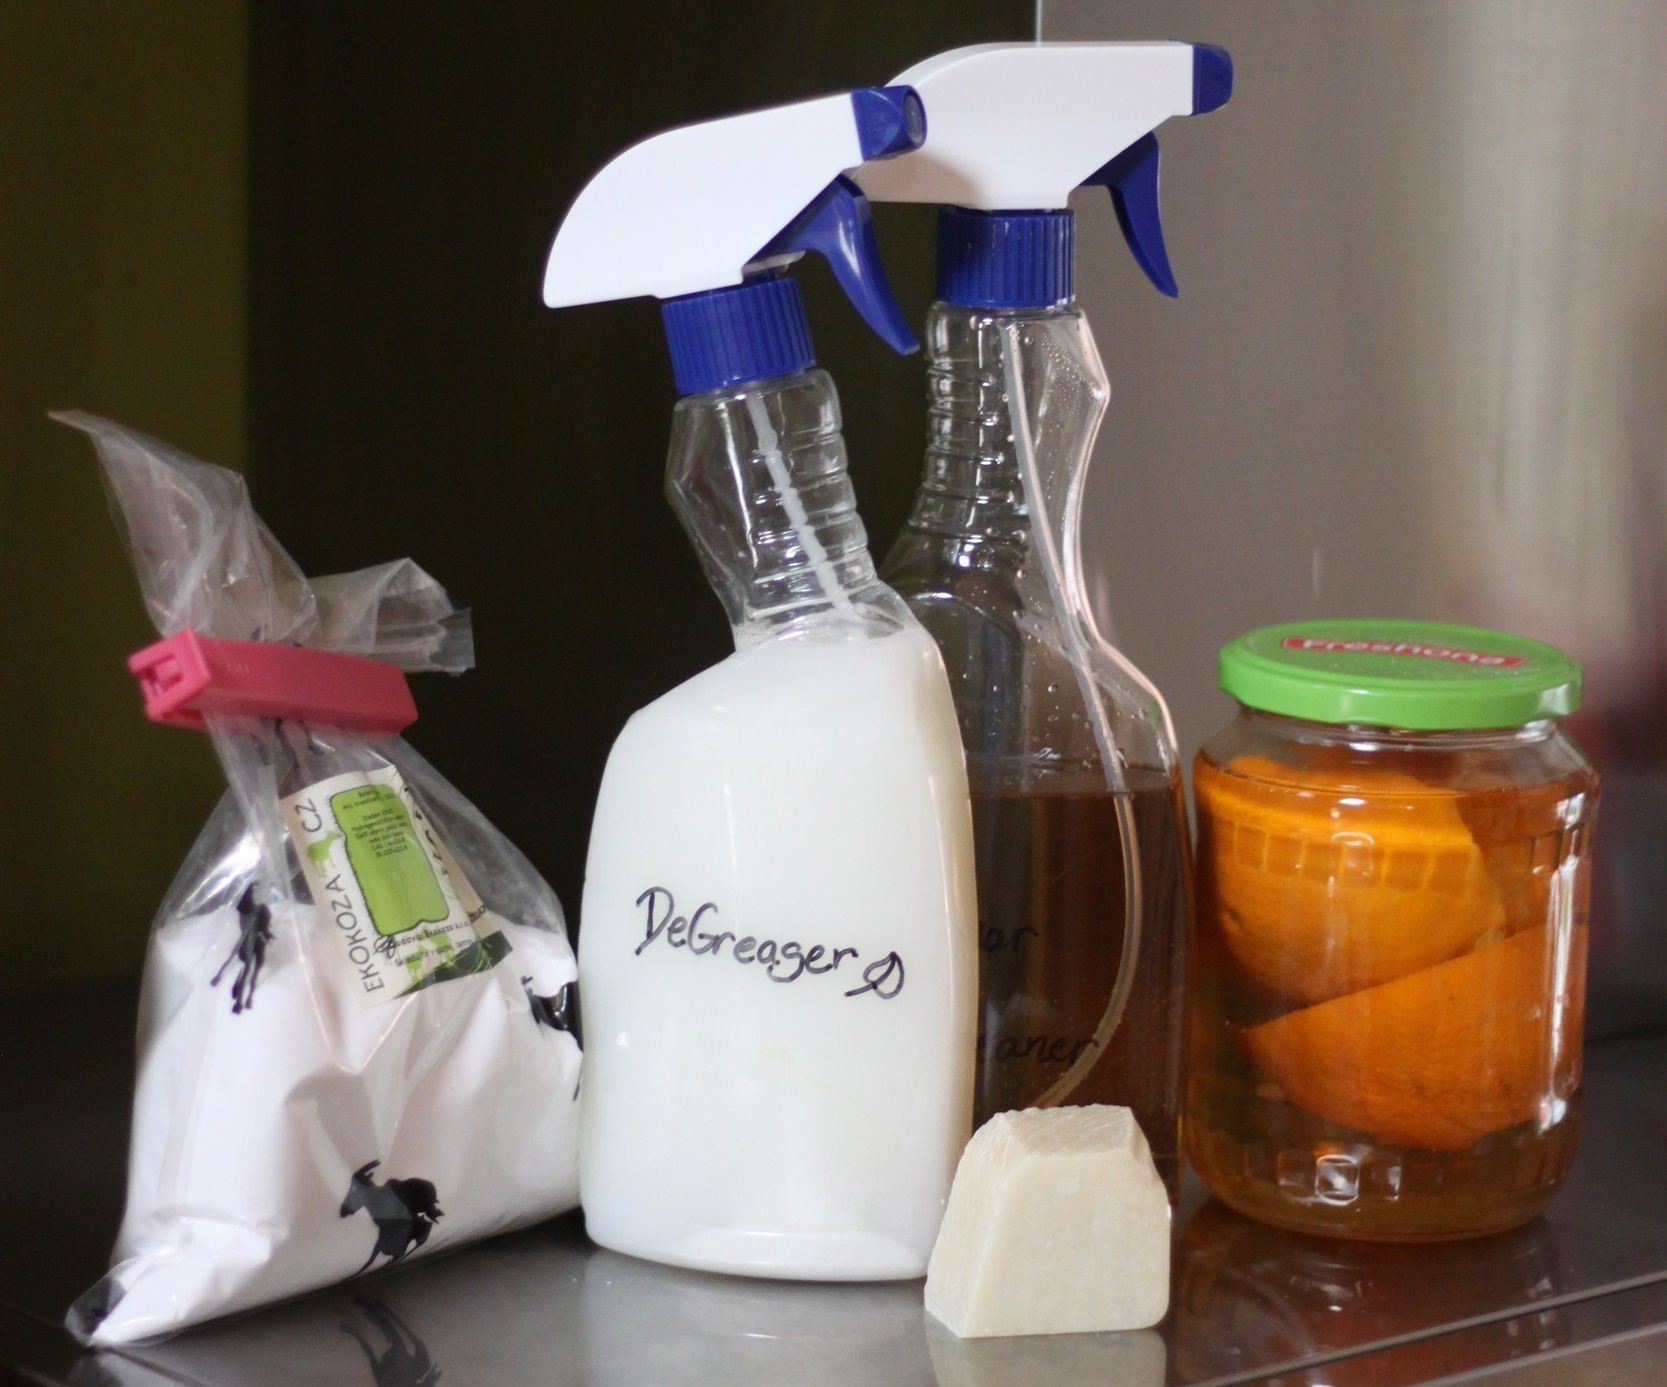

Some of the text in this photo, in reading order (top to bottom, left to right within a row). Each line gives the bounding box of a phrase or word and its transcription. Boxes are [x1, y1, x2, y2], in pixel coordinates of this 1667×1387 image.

[1302, 638, 1506, 665] Freshona
[295, 797, 323, 834] CZ
[326, 873, 385, 993] EKOKOZA
[979, 924, 1038, 953] ar
